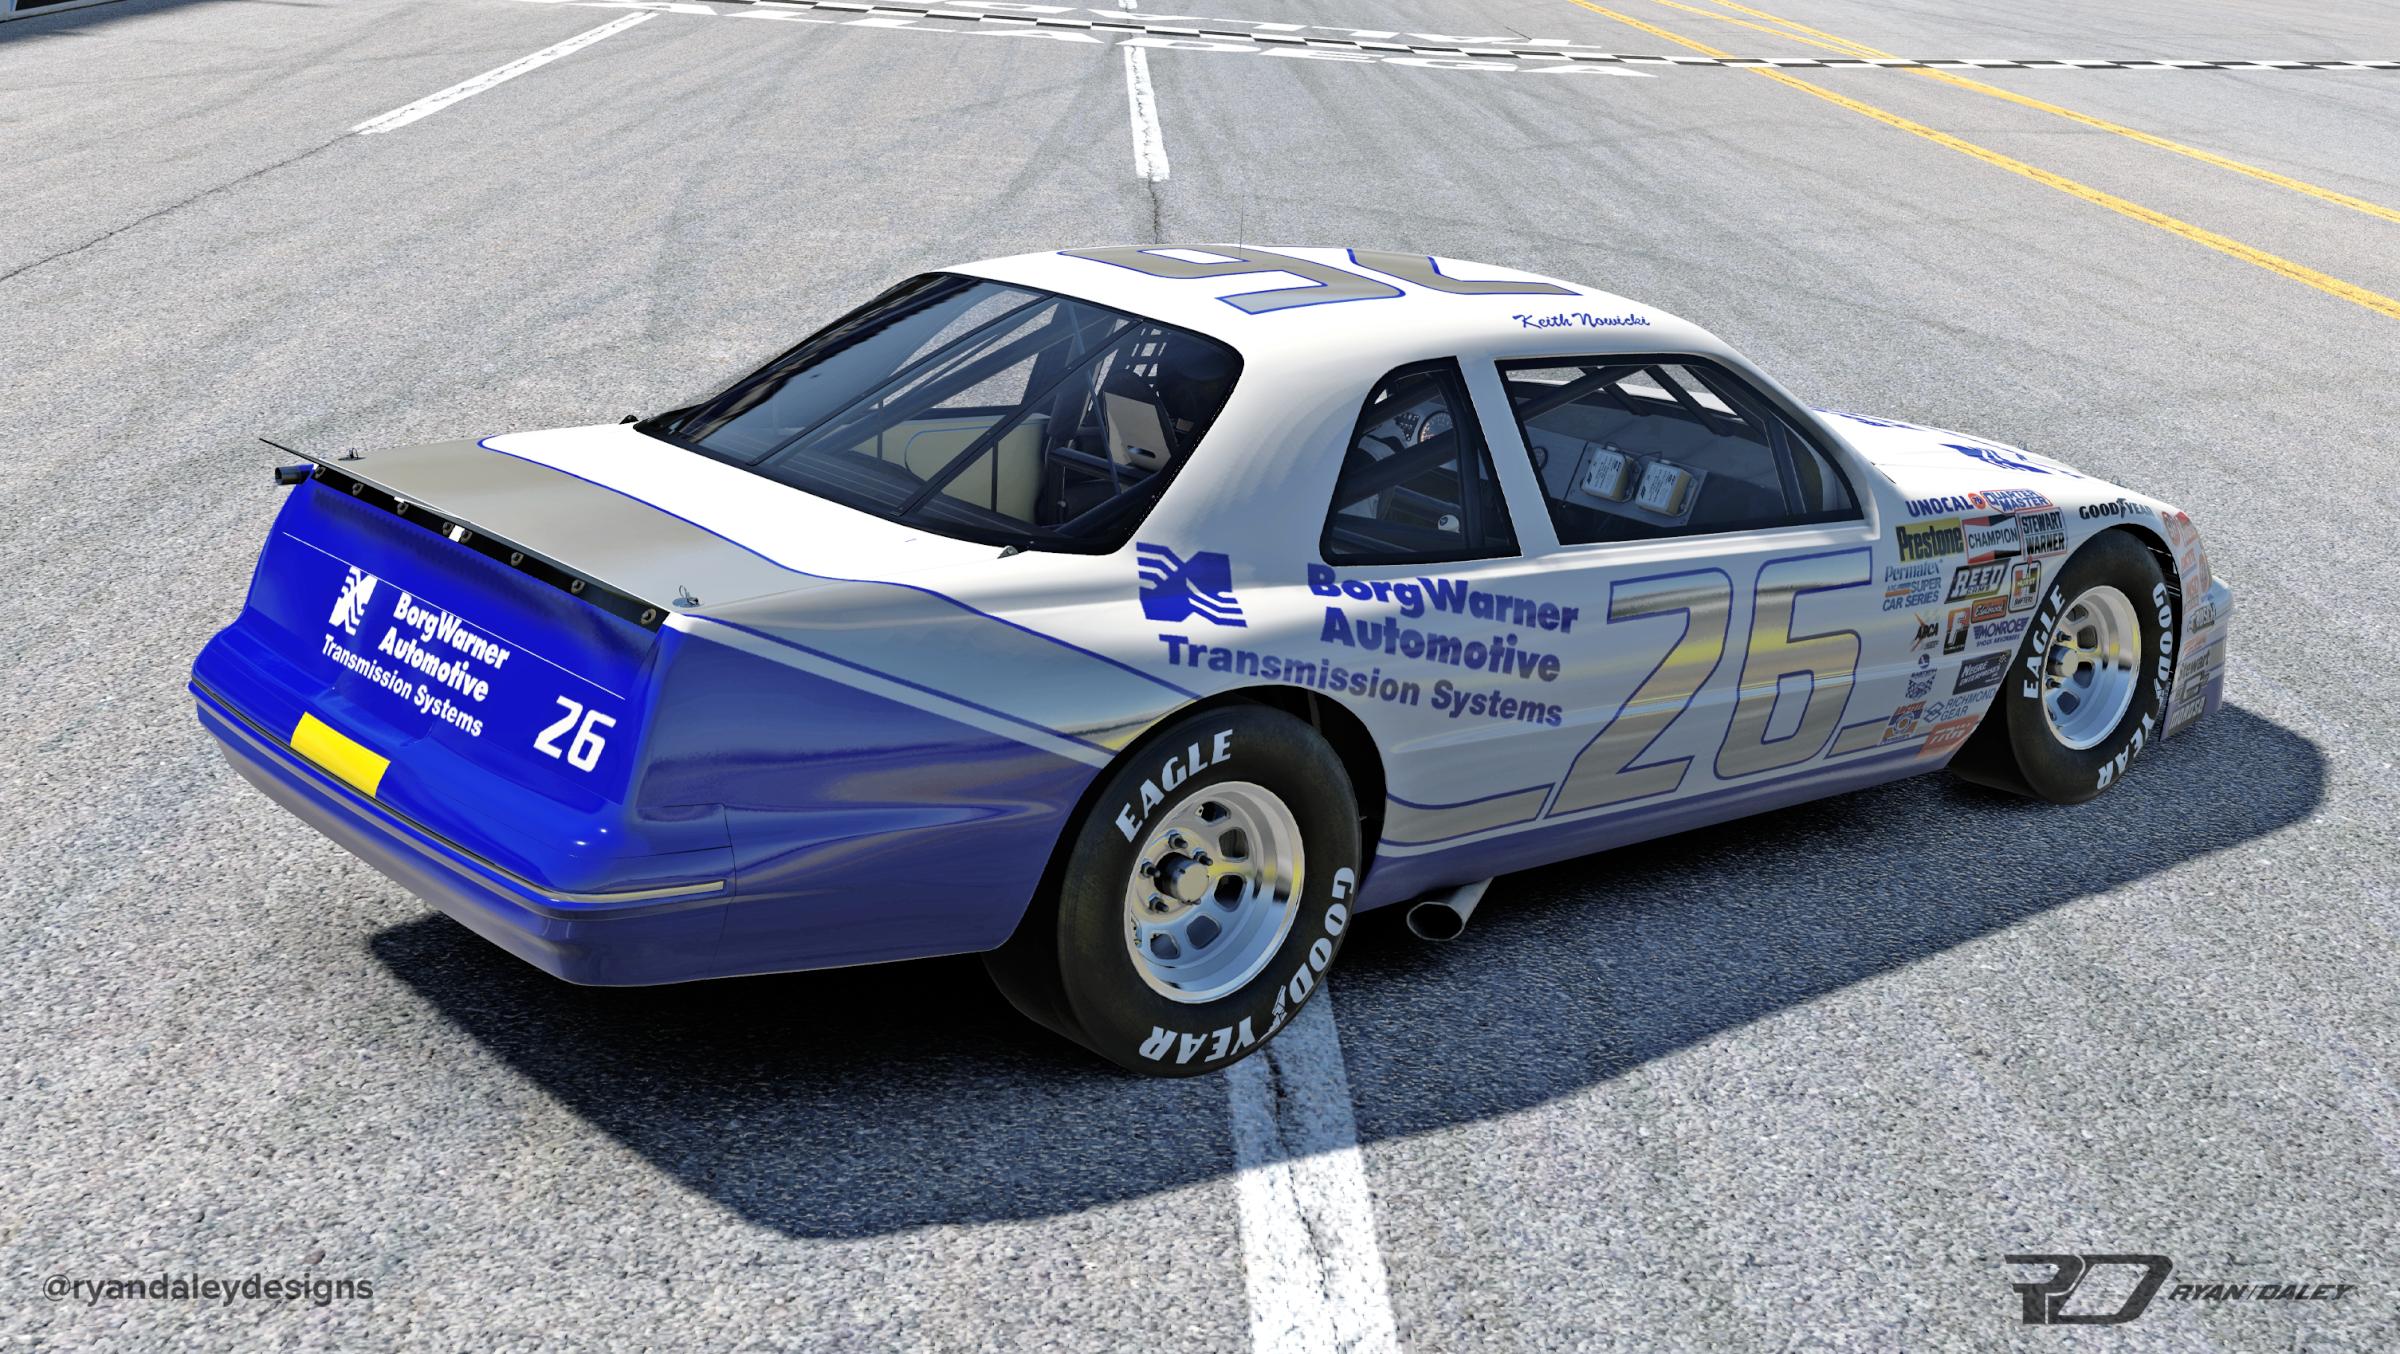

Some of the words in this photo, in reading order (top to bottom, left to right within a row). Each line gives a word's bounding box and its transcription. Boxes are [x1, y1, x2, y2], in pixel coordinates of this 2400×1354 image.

[1512, 313, 1572, 329] Keith
[1571, 313, 1650, 328] Nowicki
[1905, 496, 1973, 518] UNOCAL
[1983, 490, 2038, 506] QUARTER
[1997, 495, 2050, 511] MASTER
[2021, 511, 2063, 533] STEWART
[1896, 526, 1964, 562] Prestone
[1969, 528, 2019, 549] CHAMPION
[2024, 533, 2065, 554] WARNER
[1885, 562, 1940, 582] Permatex
[1951, 564, 2003, 598] REED
[1911, 577, 1941, 593] SUPER
[1307, 563, 1580, 635] BorgWarner
[1882, 598, 1903, 611] CAR
[1905, 591, 1940, 607] SERIES
[393, 591, 511, 670] BorgWarner
[1974, 617, 2027, 639] MONROE
[1320, 606, 1561, 683] Automotive
[2023, 584, 2065, 699] EAGLE
[378, 626, 489, 702] Automotive
[322, 634, 412, 701] Transmission
[413, 684, 484, 738] Systems
[1158, 633, 1421, 705] Transmission
[1430, 680, 1563, 727] Systems
[1543, 546, 1873, 819] 26
[1944, 687, 1997, 710] RICHMOND
[1940, 705, 1969, 722] GEAR
[533, 695, 617, 773] 26
[1115, 728, 1234, 843] EAGLE
